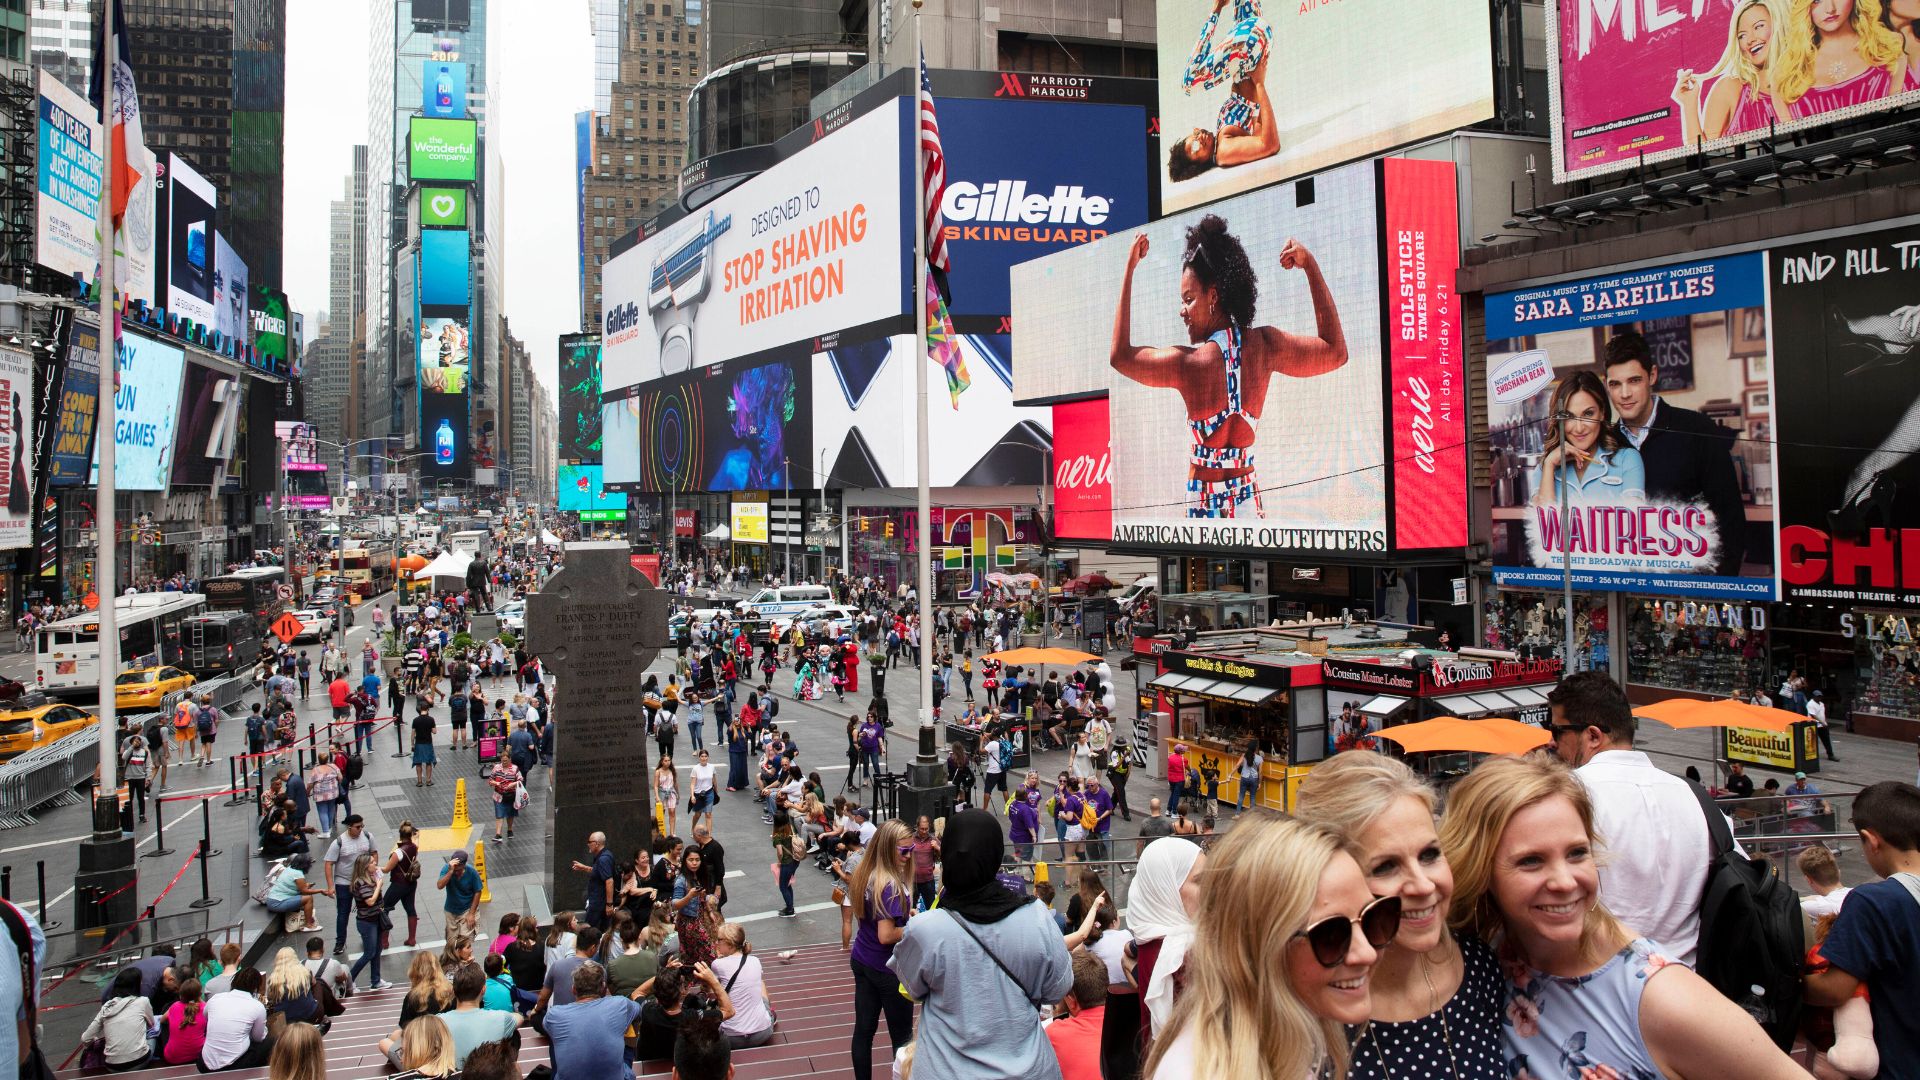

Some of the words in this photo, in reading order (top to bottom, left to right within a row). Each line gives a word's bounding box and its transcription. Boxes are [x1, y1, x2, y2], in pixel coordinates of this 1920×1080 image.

[1031, 76, 1093, 87] MARRIOTT
[1031, 87, 1087, 98] MARQUIS
[825, 100, 853, 121] MARRIOTT
[825, 113, 850, 132] MARQUIS
[50, 104, 65, 131] 400
[66, 115, 88, 147] YEARS
[50, 128, 60, 151] OF
[61, 135, 77, 162] LAW
[414, 141, 473, 154] Wonderful
[429, 136, 443, 144] the
[50, 153, 69, 180] JUST
[70, 164, 99, 198] ARRIVED
[683, 159, 709, 177] MARRIOTT
[49, 175, 58, 198] IN
[751, 196, 801, 238] DESIGNED
[804, 186, 820, 209] TO
[941, 179, 1110, 226] Gillette
[724, 247, 765, 293] STOP
[772, 203, 868, 275] SHAVING
[1416, 231, 1426, 289] SQUARE
[1782, 251, 1837, 285] AND
[1845, 247, 1890, 277] ALL
[740, 258, 844, 327] IRRITATION
[1398, 230, 1416, 342] SOLSTICE
[1514, 289, 1552, 302] ORIGINAL
[1553, 286, 1578, 297] MUSIC
[1580, 283, 1591, 293] BY
[1592, 279, 1620, 291] 7-TIME
[1669, 264, 1715, 279] NOMINEE
[1437, 284, 1448, 315] 6.21
[1514, 298, 1573, 323] SARA
[1582, 275, 1716, 314] BAREILLES
[606, 301, 639, 336] Gillette
[1417, 292, 1428, 342] TIMES
[186, 318, 276, 372] BROADWAY
[606, 327, 639, 349] SKINGUARD
[1438, 317, 1452, 368] Friday
[1438, 372, 1452, 397] day
[1494, 373, 1511, 386] NOW
[1511, 359, 1544, 381] STARRING
[1496, 373, 1528, 396] SHOSHANA
[1528, 367, 1546, 384] BEAN
[63, 390, 96, 415] COME
[1439, 401, 1451, 422] All
[59, 411, 94, 434] FROM
[115, 420, 156, 448] GAMES
[1402, 376, 1436, 474] aerie
[55, 432, 90, 455] AWAY
[638, 503, 650, 519] BIG
[639, 519, 650, 529] BOLD
[1113, 525, 1194, 544] AMERICAN
[1200, 527, 1254, 547] EAGLE
[1258, 530, 1385, 552] OUTFITTERS
[1536, 504, 1709, 558] WAITRESS
[943, 507, 1016, 600] T
[1571, 557, 1587, 565] HIT
[1588, 557, 1643, 567] BROADWAY
[1646, 559, 1693, 569] MUSICAL
[1780, 524, 1920, 589] CHI
[1526, 573, 1561, 581] ATKINSON
[1563, 575, 1594, 583] TEATRE
[1598, 576, 1612, 584] 256
[1637, 578, 1648, 586] ST.
[1652, 579, 1769, 593] WAITRESSTHEMUSICAL.COM
[1798, 588, 1855, 600] AMBASSADOR
[1857, 591, 1896, 602] THEATRE
[554, 612, 598, 623] FRANCIS
[609, 611, 643, 621] DUFFY
[761, 605, 782, 613] NYPD
[1663, 601, 1766, 631] GRAND
[1332, 666, 1361, 680] Cousins
[1361, 670, 1384, 684] Maine
[1384, 673, 1414, 689] Lobster
[1448, 665, 1493, 684] Cousins
[1524, 655, 1563, 675] Lobster
[1728, 729, 1791, 753] Beautiful
